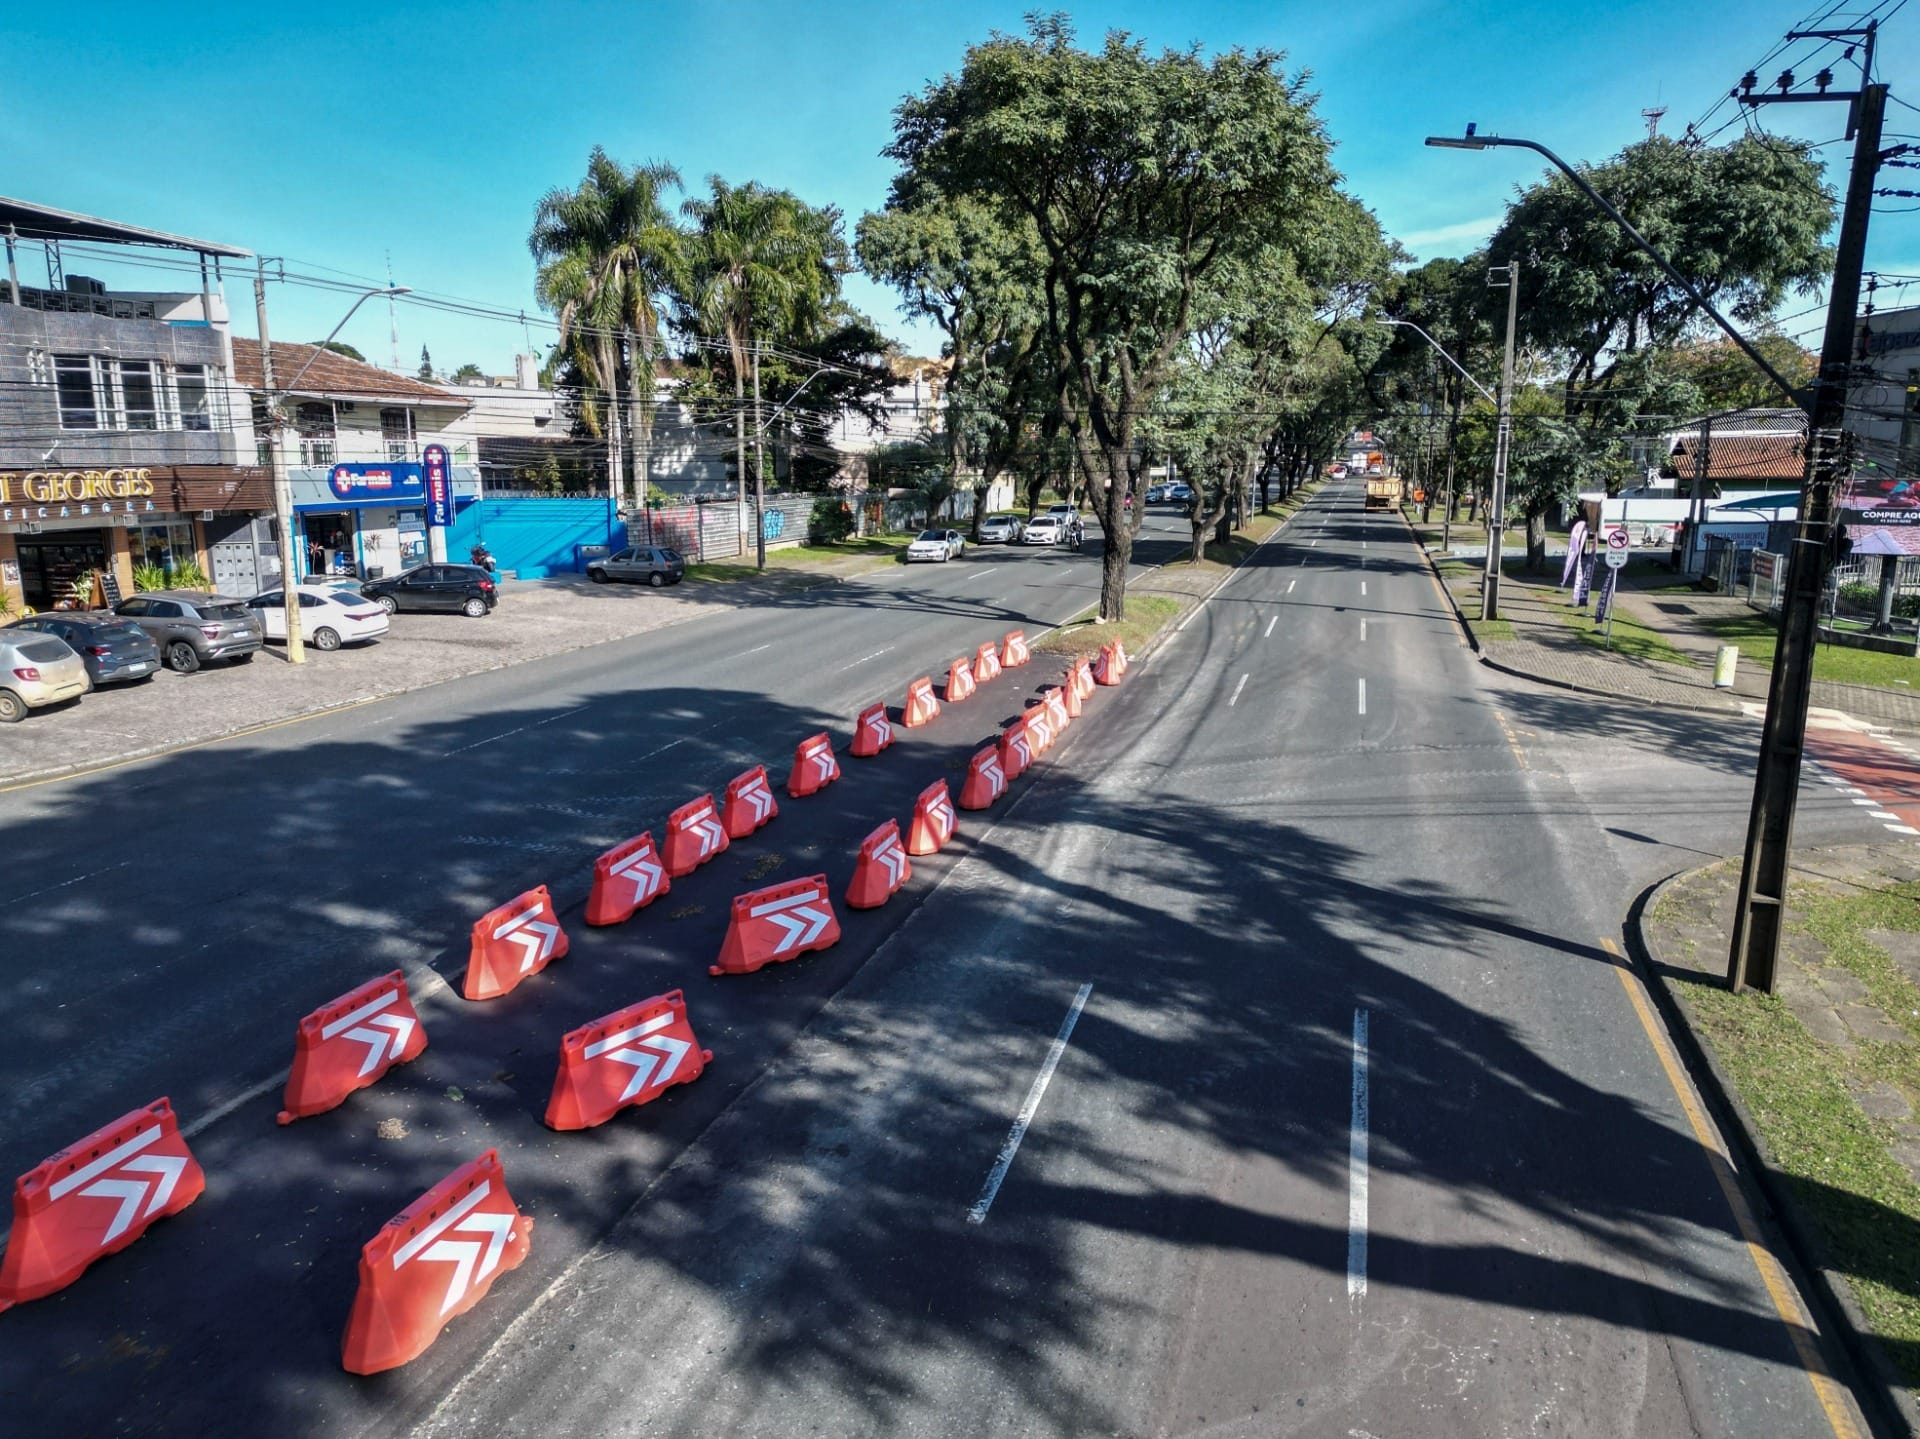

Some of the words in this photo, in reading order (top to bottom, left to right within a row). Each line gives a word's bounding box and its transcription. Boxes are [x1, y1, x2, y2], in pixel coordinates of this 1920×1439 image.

[23, 468, 154, 502] GEORGES
[432, 468, 445, 523] Farmais
[1862, 511, 1902, 519] COMPRE
